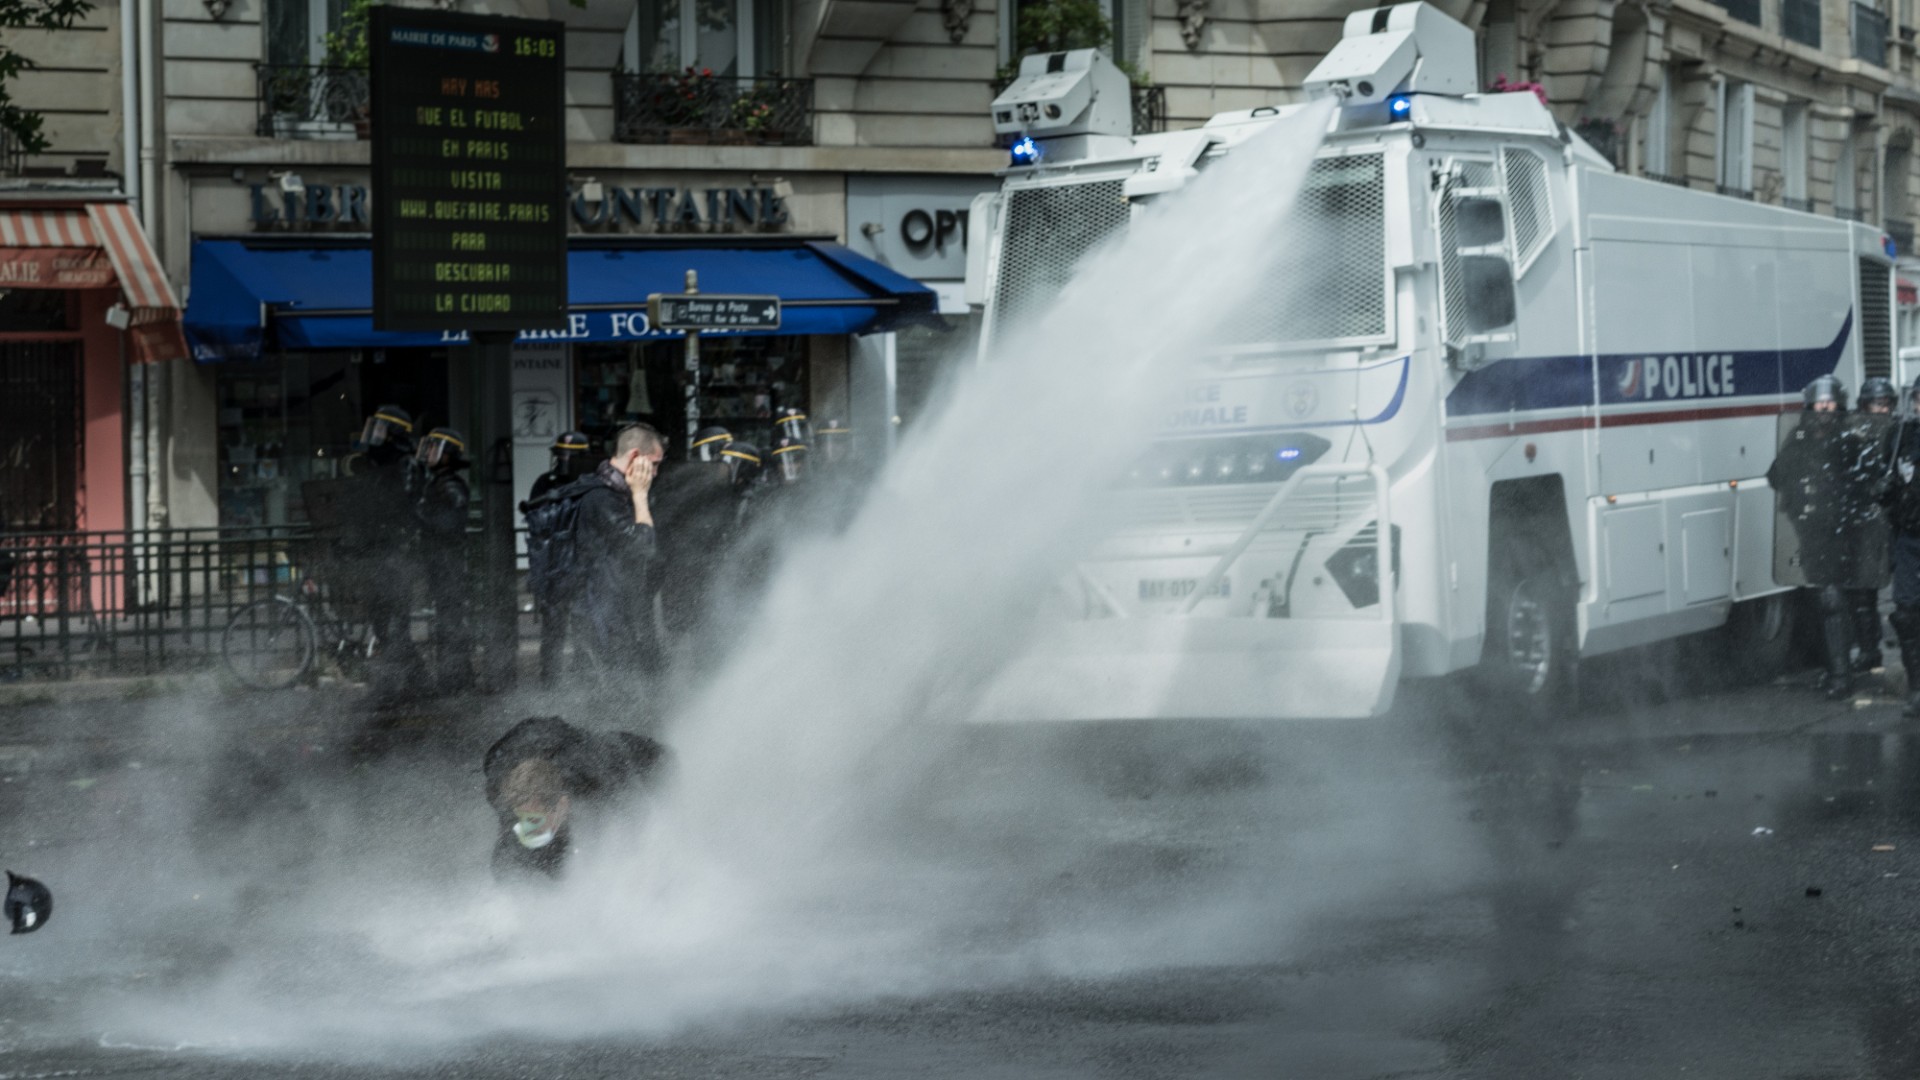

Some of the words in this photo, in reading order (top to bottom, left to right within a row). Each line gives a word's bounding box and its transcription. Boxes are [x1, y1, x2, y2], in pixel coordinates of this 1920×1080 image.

[391, 30, 428, 45] MAIRIE
[432, 33, 445, 45] DE
[448, 35, 477, 48] PARIS
[515, 36, 556, 57] 16:03
[416, 106, 442, 125] QUE
[450, 108, 467, 127] EL
[475, 110, 524, 131] FUTBOL
[467, 141, 508, 160] PARIS
[450, 170, 501, 189] VISITA
[250, 183, 367, 223] LIBR
[571, 186, 788, 225] ONTAINE
[901, 209, 970, 252] OPT
[452, 232, 486, 251] PARA
[0, 261, 40, 283] ALIE
[435, 263, 510, 282] DESCUBRIR
[436, 294, 453, 312] LA
[461, 294, 511, 312] CIUDAD
[1644, 354, 1734, 398] POLICE
[1185, 384, 1221, 402] ICE
[1167, 405, 1247, 427] ONALE
